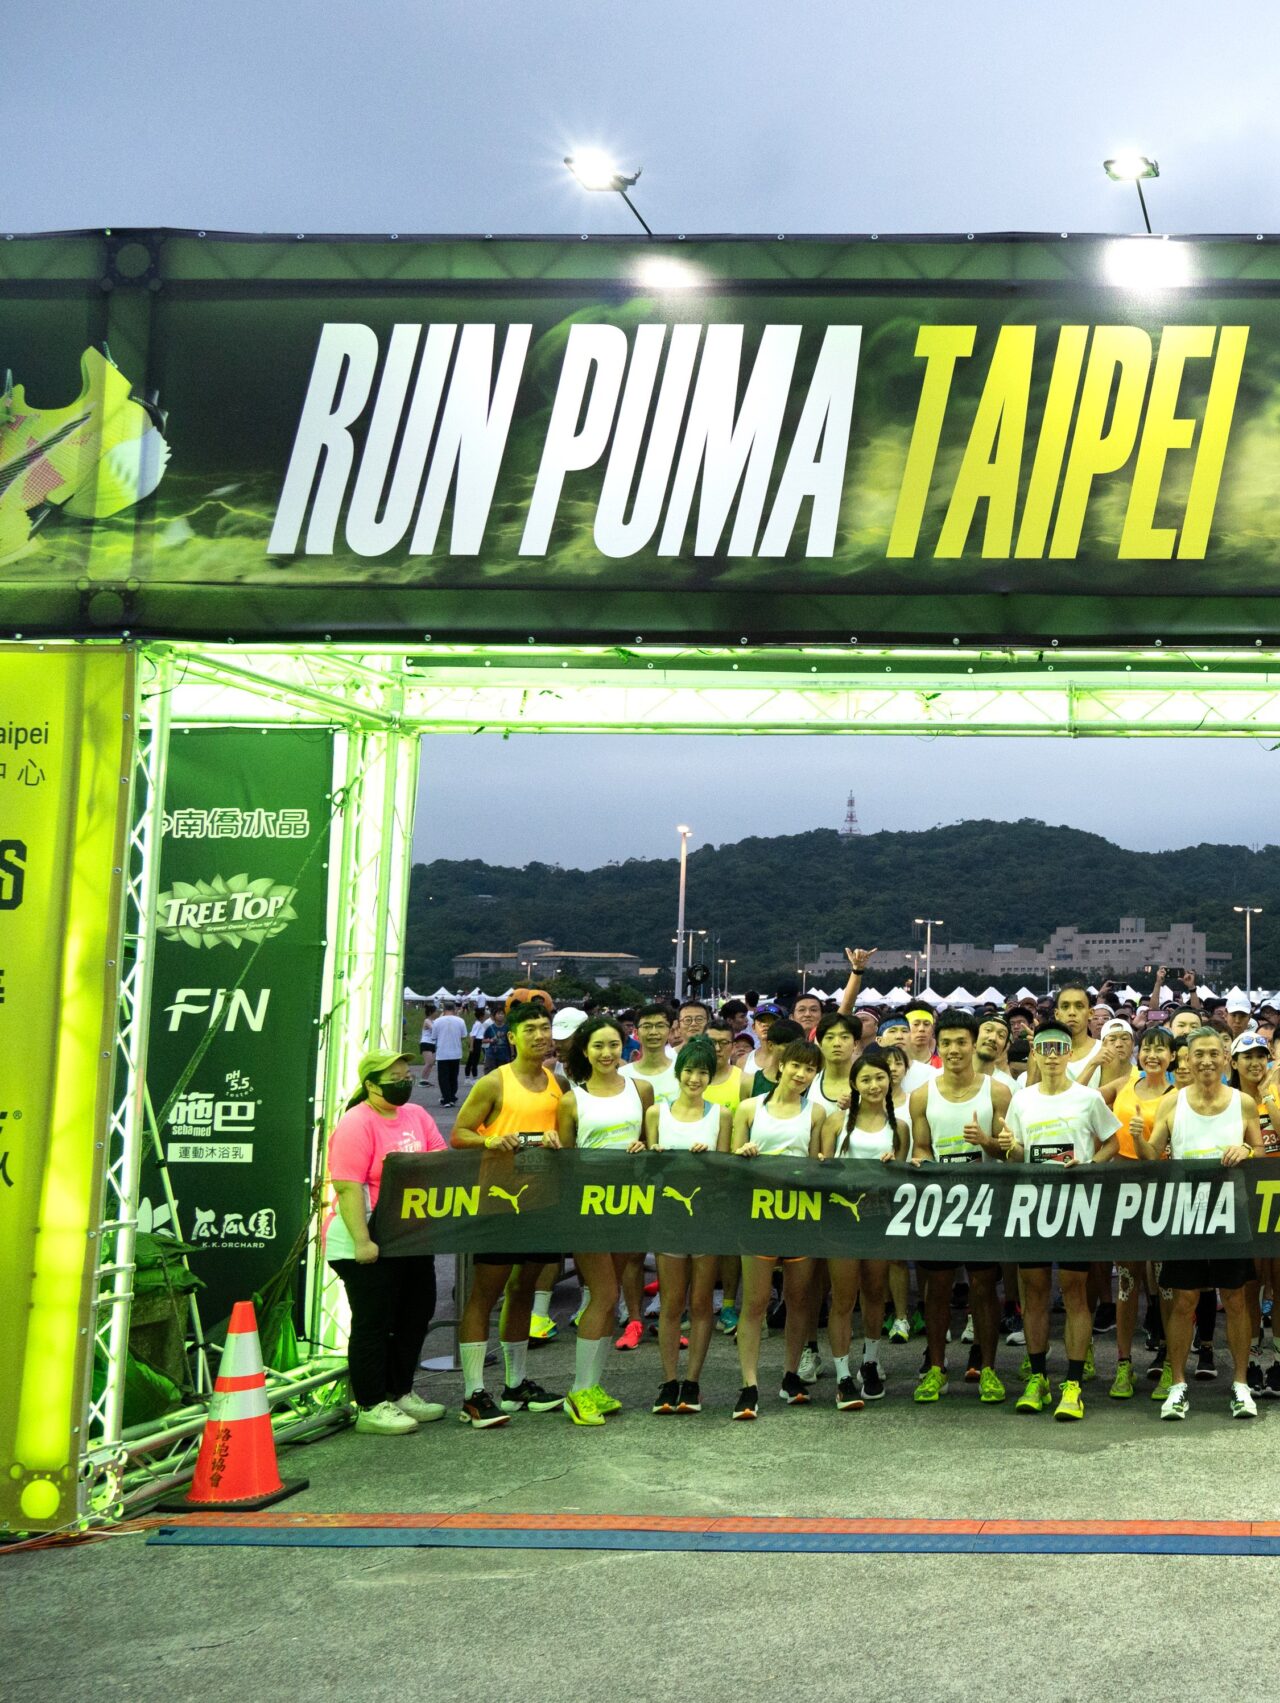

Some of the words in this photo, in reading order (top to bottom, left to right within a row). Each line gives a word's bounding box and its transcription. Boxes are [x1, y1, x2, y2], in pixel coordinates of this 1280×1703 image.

[266, 323, 533, 557] RUN
[518, 323, 863, 558] PUMA
[886, 325, 1250, 560] TAIPEI
[172, 808, 309, 838] 南僑水晶
[164, 898, 227, 928] TREE
[230, 892, 285, 921] TOP
[163, 988, 270, 1032] FIN
[226, 1070, 241, 1082] pH
[230, 1077, 250, 1091] 5.5
[167, 1092, 256, 1132] 施巴
[178, 1146, 244, 1160] 運動沐浴乳
[400, 1185, 481, 1219] RUN
[580, 1185, 655, 1215] RUN
[751, 1189, 822, 1221] RUN
[885, 1183, 994, 1237] 2024
[1004, 1183, 1102, 1238] RUN
[1111, 1181, 1236, 1237] PUMA
